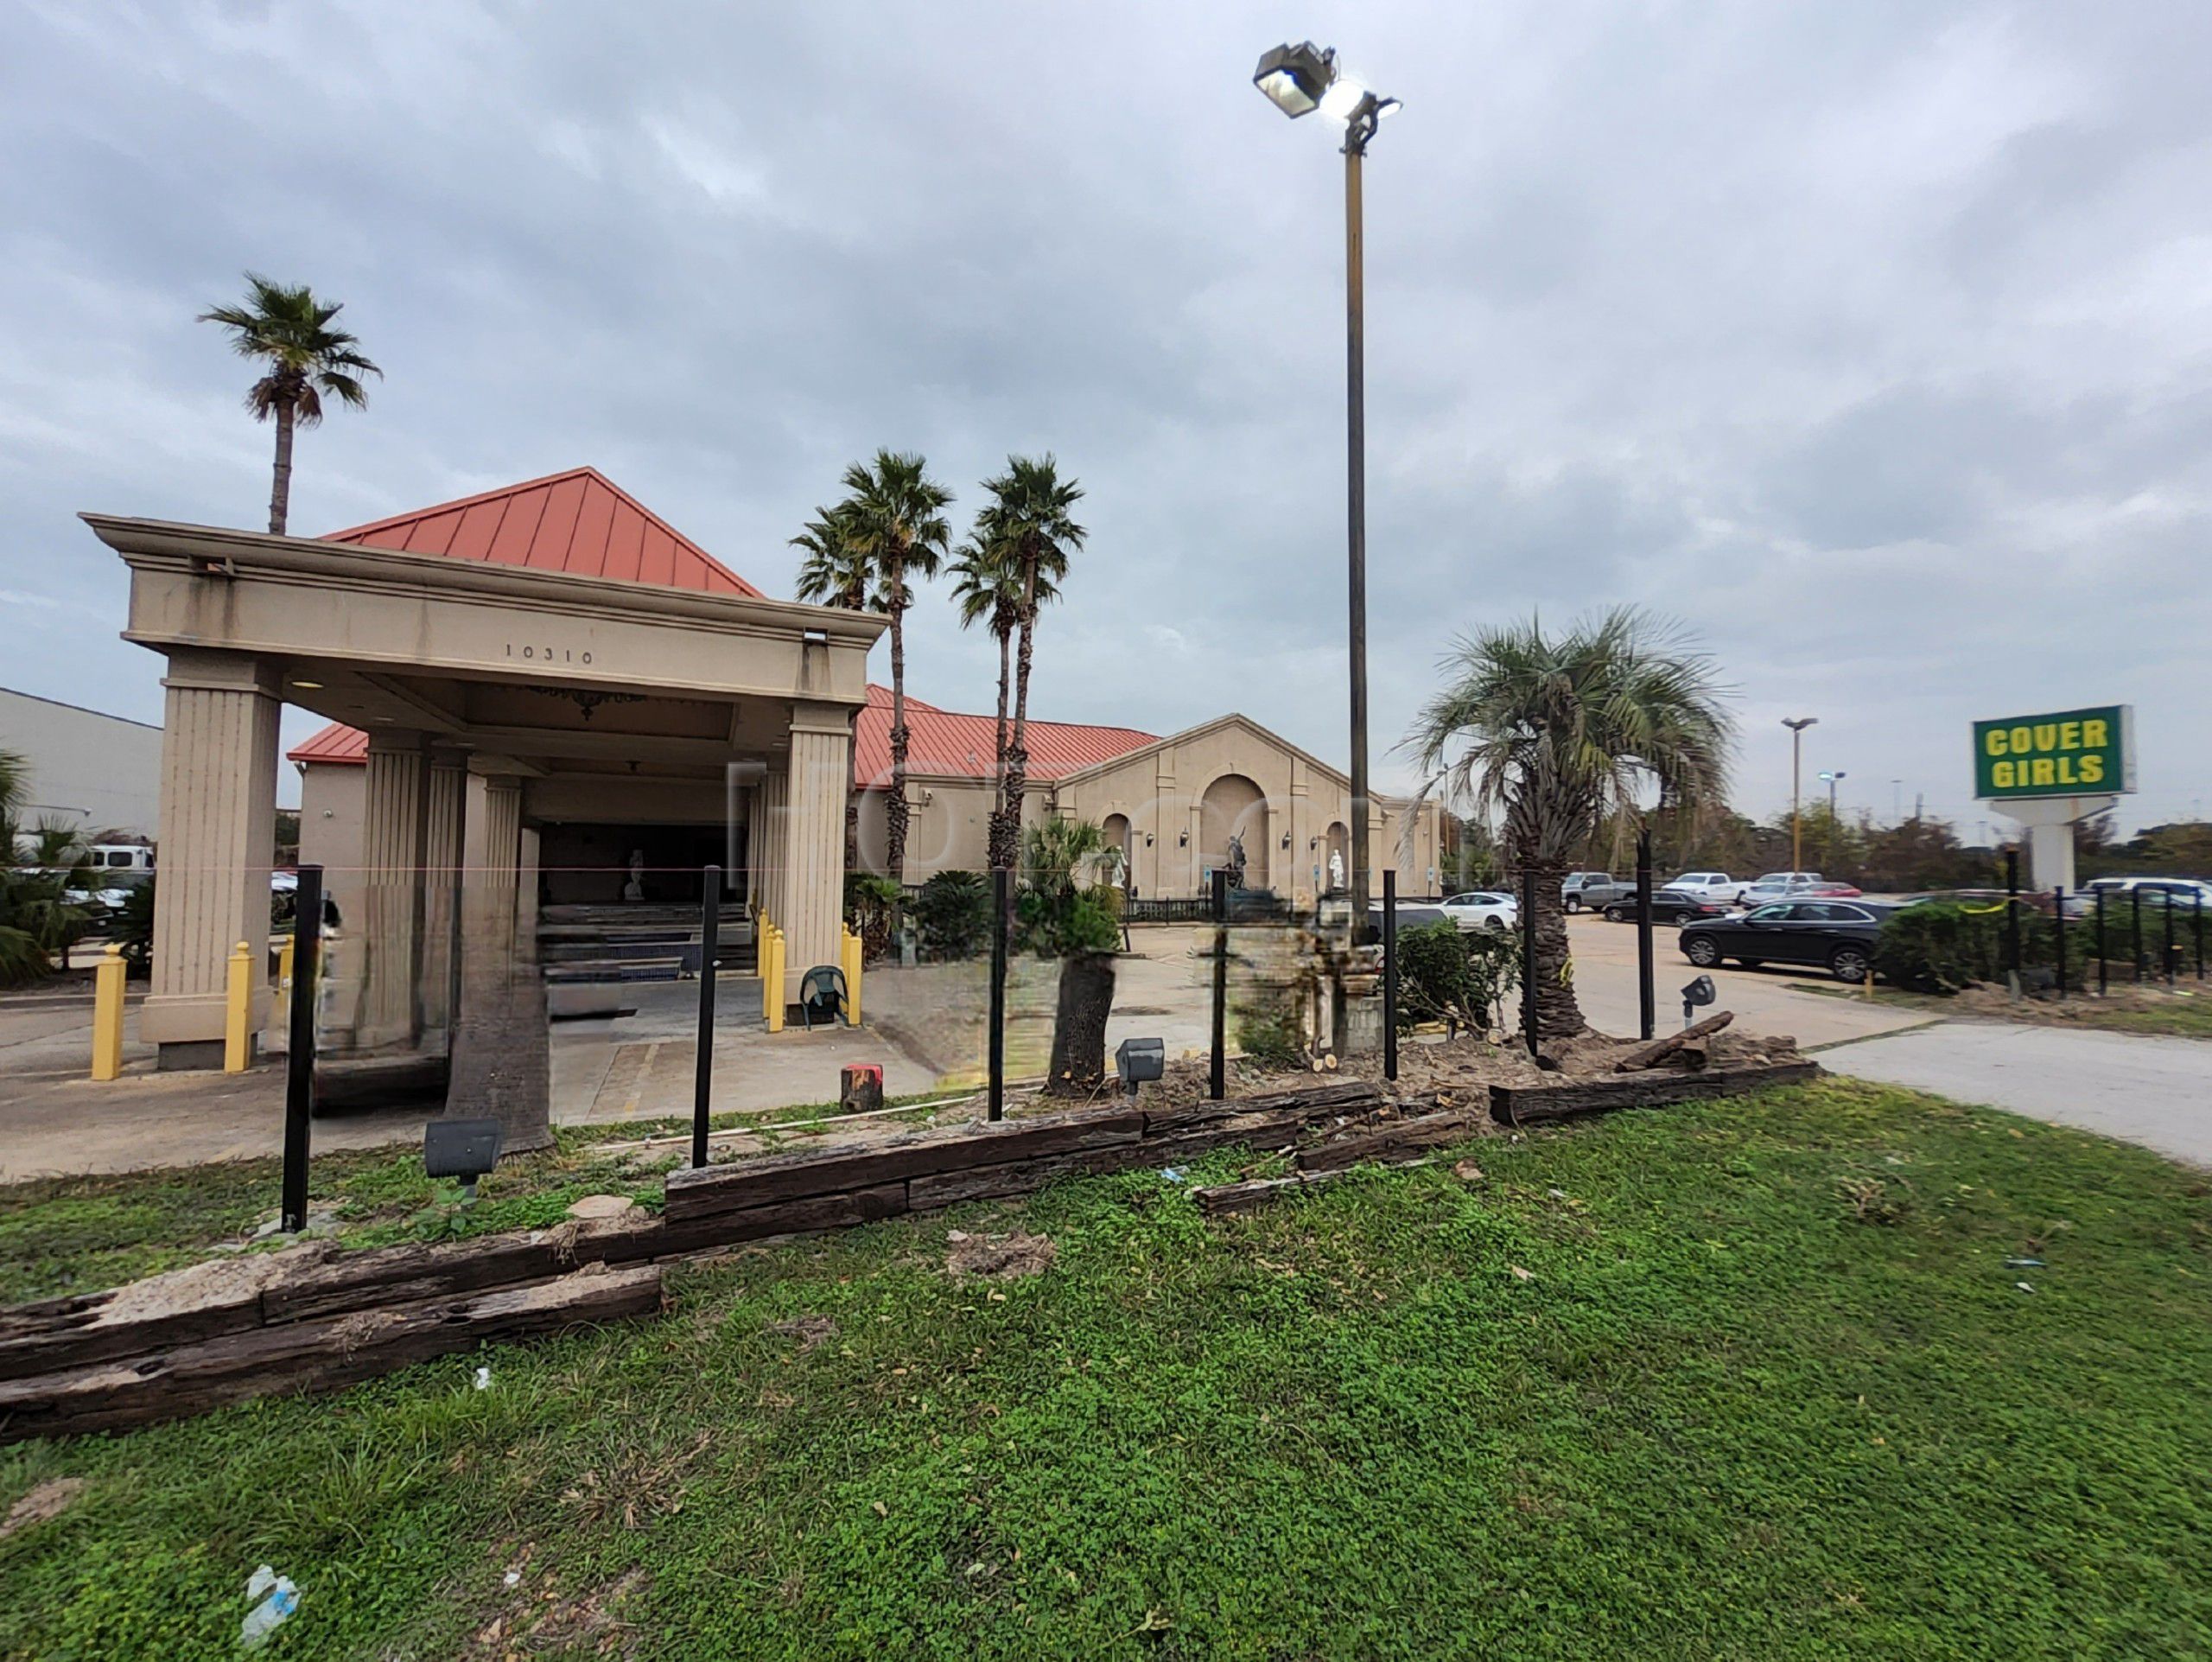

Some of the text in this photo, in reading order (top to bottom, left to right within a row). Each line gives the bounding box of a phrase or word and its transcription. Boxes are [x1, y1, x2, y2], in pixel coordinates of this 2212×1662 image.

[506, 644, 592, 664] 10310
[1986, 719, 2107, 756] COVER
[1992, 755, 2104, 788] GIRLS
